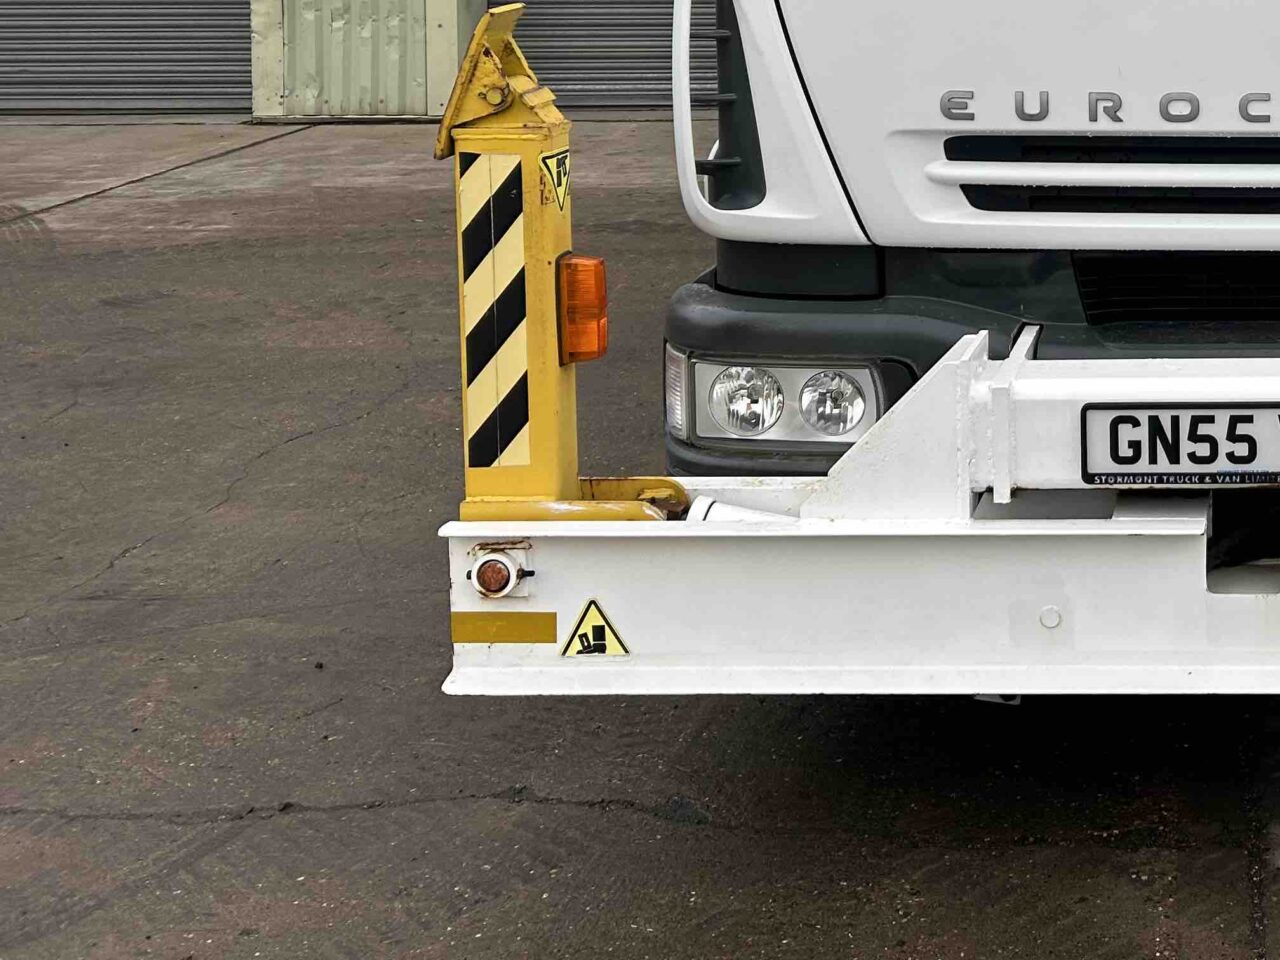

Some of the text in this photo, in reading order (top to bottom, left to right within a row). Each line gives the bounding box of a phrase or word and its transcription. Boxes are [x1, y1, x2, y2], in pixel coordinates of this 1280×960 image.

[1110, 415, 1257, 465] GN55
[1162, 475, 1200, 484] TRUCK
[1216, 475, 1240, 483] VAN
